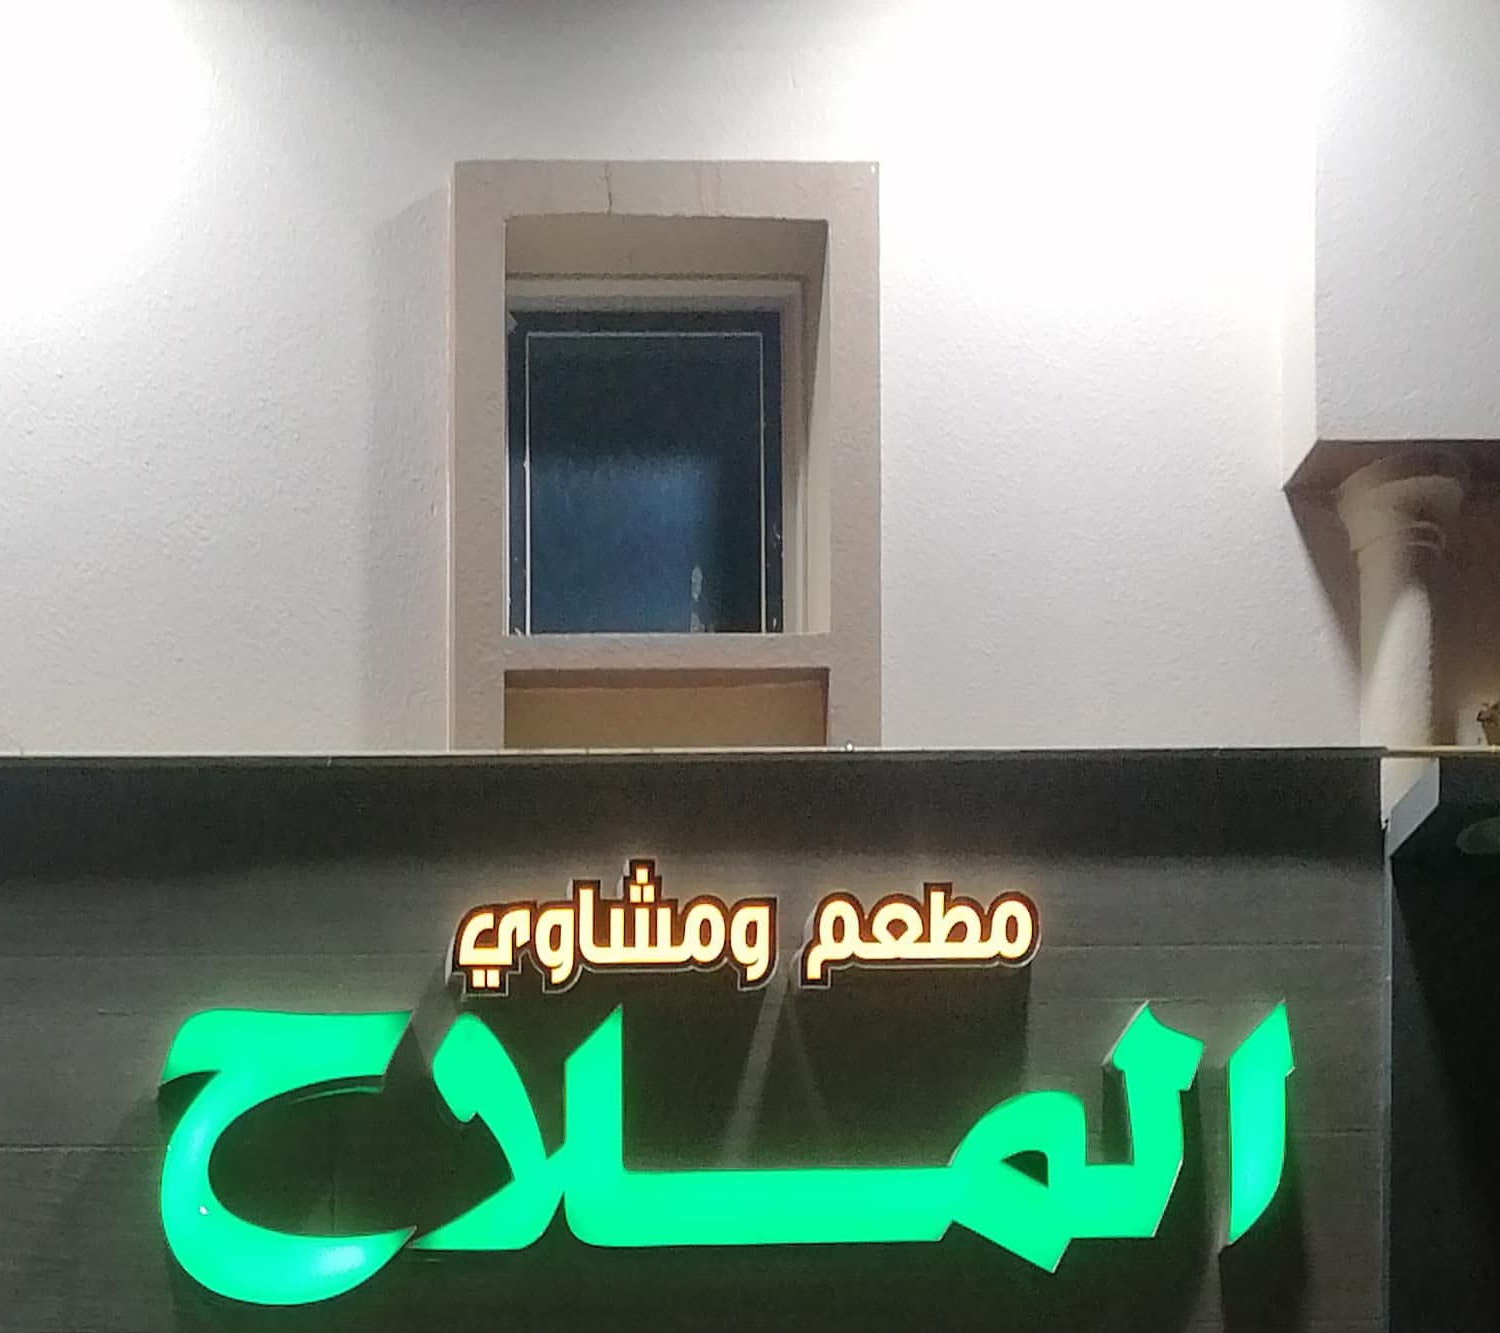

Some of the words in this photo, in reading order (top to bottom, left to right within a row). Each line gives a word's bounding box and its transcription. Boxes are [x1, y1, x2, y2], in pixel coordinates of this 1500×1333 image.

[457, 866, 773, 988] ومشاوي
[802, 888, 1034, 981] مطعم
[160, 1002, 1293, 1305] الملاح
